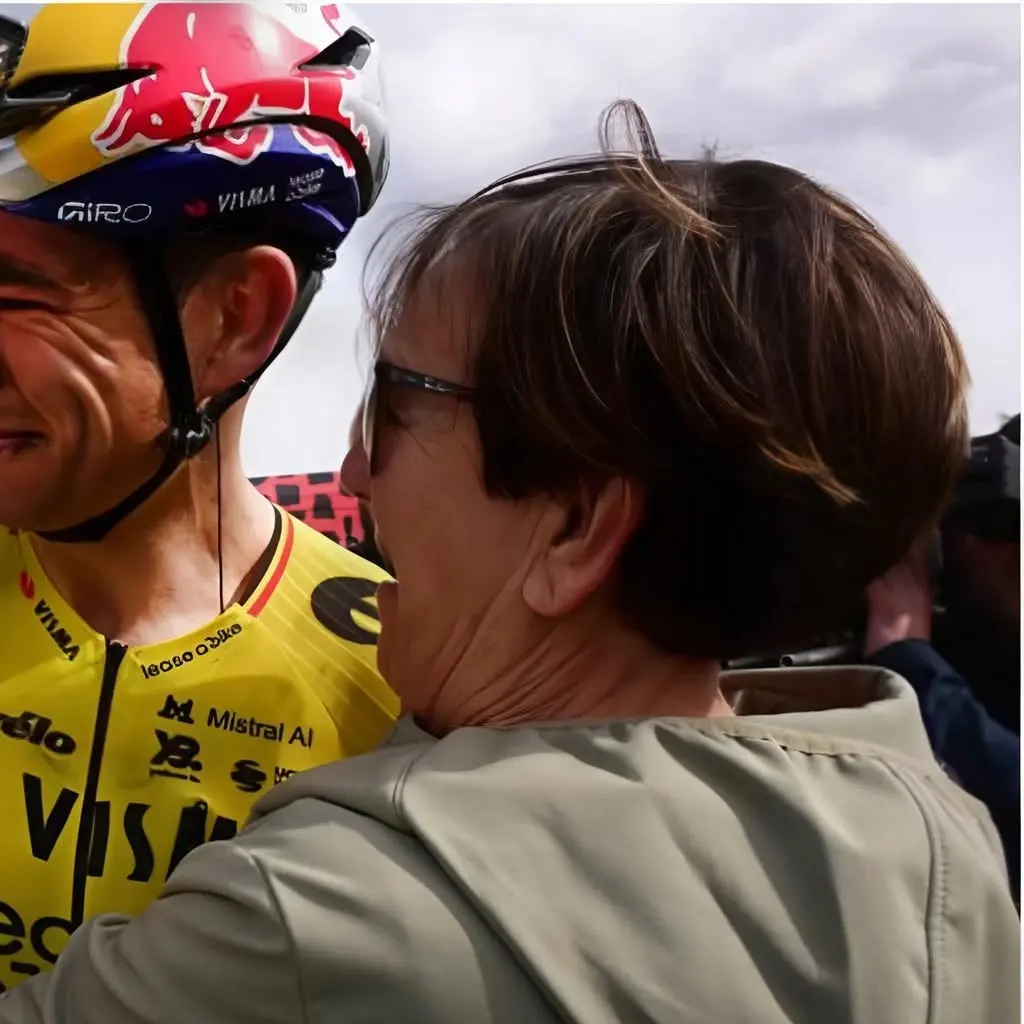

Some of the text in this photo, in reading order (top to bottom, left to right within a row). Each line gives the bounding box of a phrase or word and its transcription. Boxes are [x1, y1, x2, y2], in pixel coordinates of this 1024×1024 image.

[58, 202, 152, 224] GIRO
[34, 599, 81, 661] VISMA
[207, 707, 313, 748] Mistral AI
